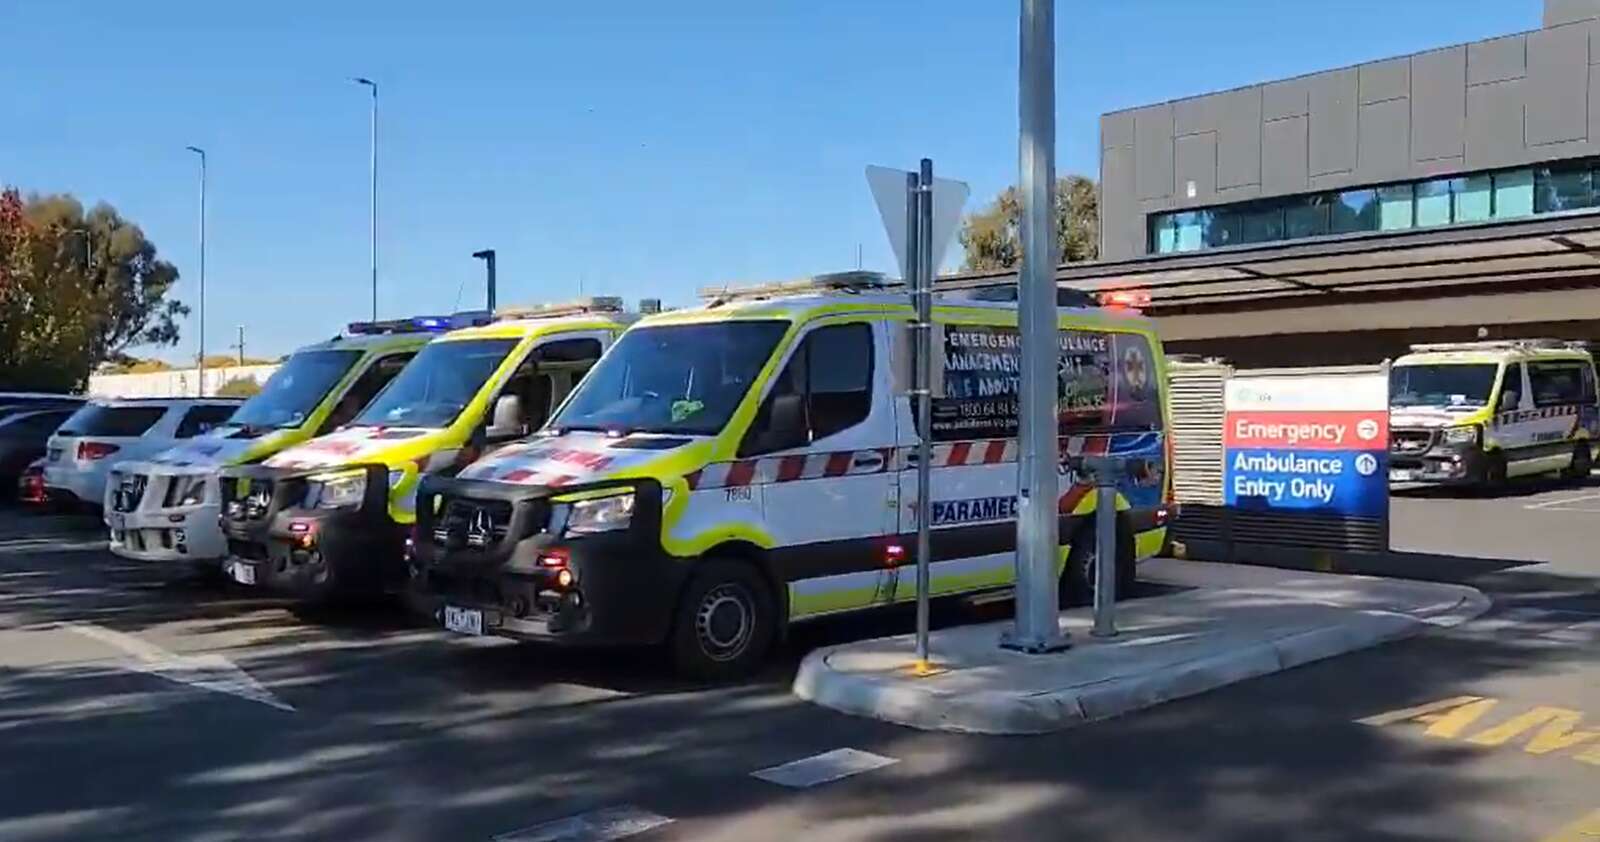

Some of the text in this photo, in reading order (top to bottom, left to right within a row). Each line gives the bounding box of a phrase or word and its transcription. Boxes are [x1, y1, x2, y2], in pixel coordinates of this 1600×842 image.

[950, 332, 1021, 348] EMERGENC
[1235, 419, 1346, 444] Emergency
[1234, 452, 1343, 474] Ambulance
[1234, 476, 1334, 503] Entry Only
